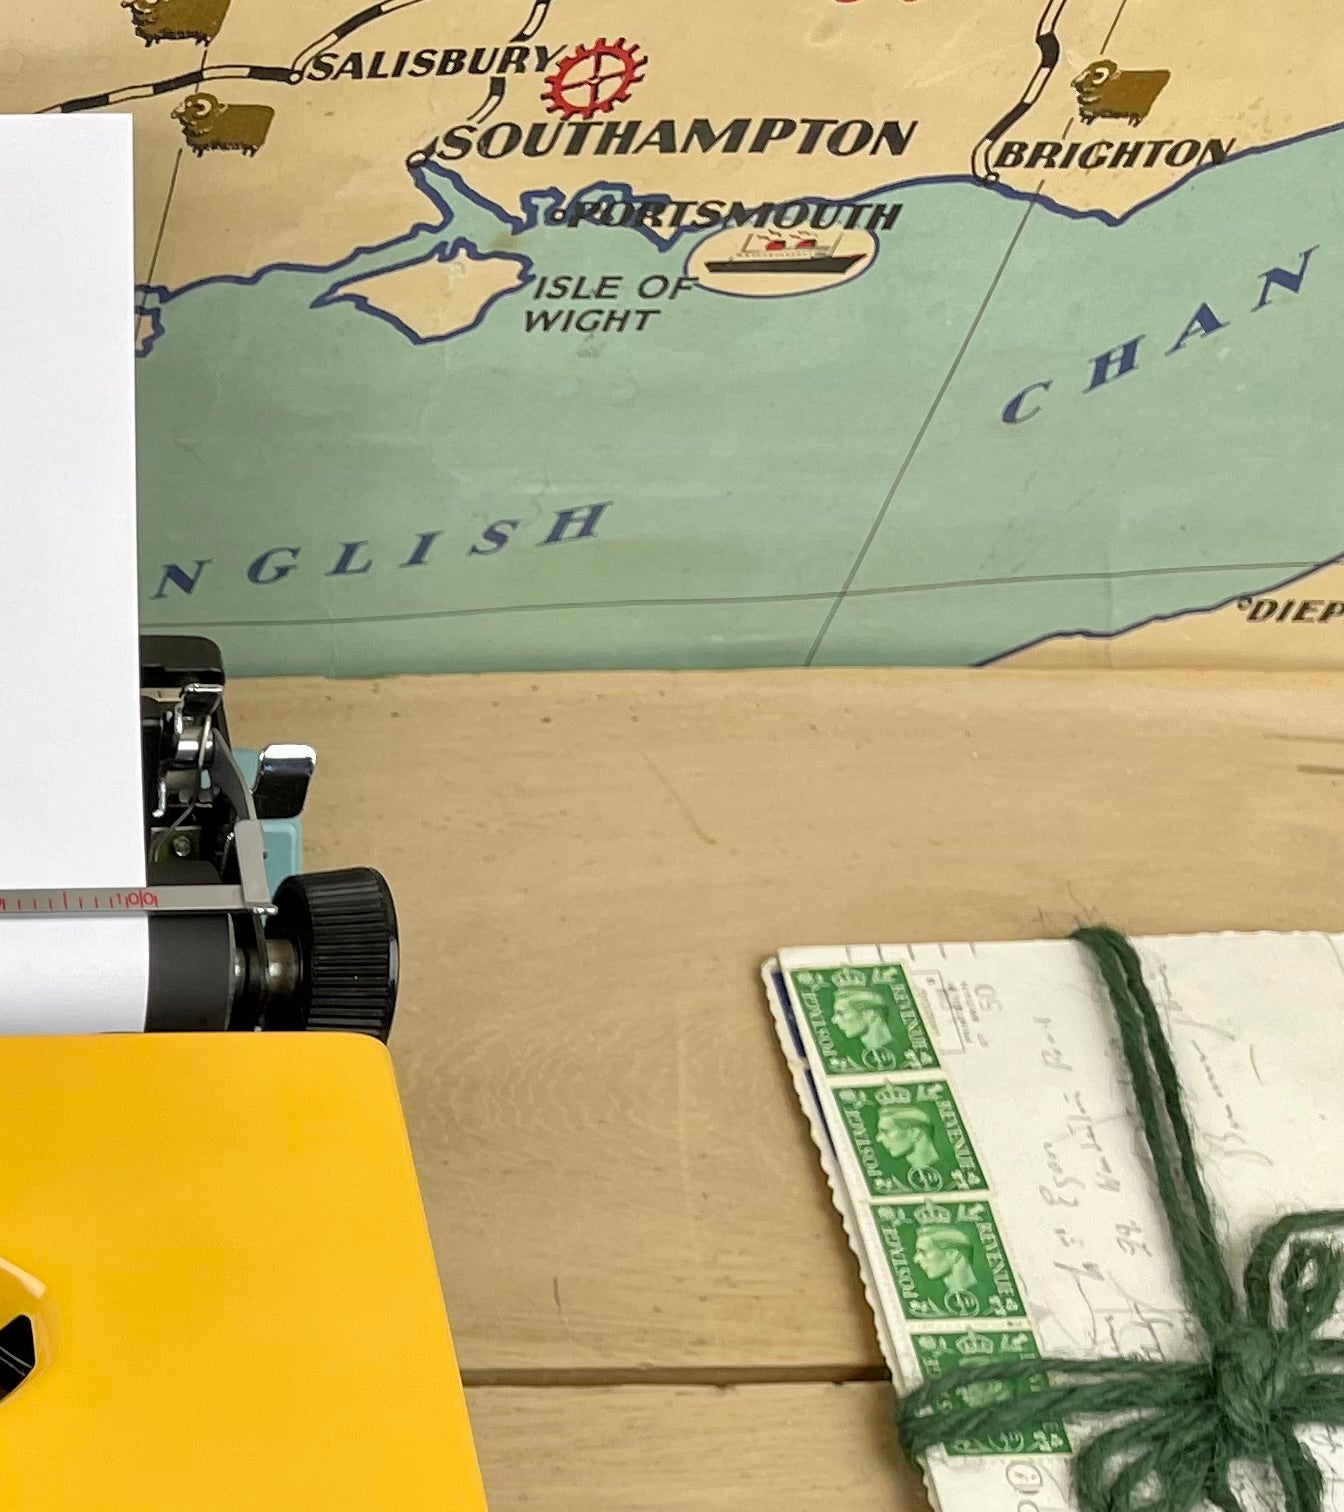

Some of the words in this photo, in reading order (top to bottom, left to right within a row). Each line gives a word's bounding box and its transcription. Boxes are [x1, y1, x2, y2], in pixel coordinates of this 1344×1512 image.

[306, 43, 568, 82] SALISBURY
[435, 117, 918, 161] SOUTHAMPTON
[993, 137, 1236, 171] BRIGHTON
[567, 200, 903, 231] PORTSMOUTH
[534, 275, 622, 300] ISLE
[637, 275, 700, 300] OF
[524, 309, 662, 333] WIGHT
